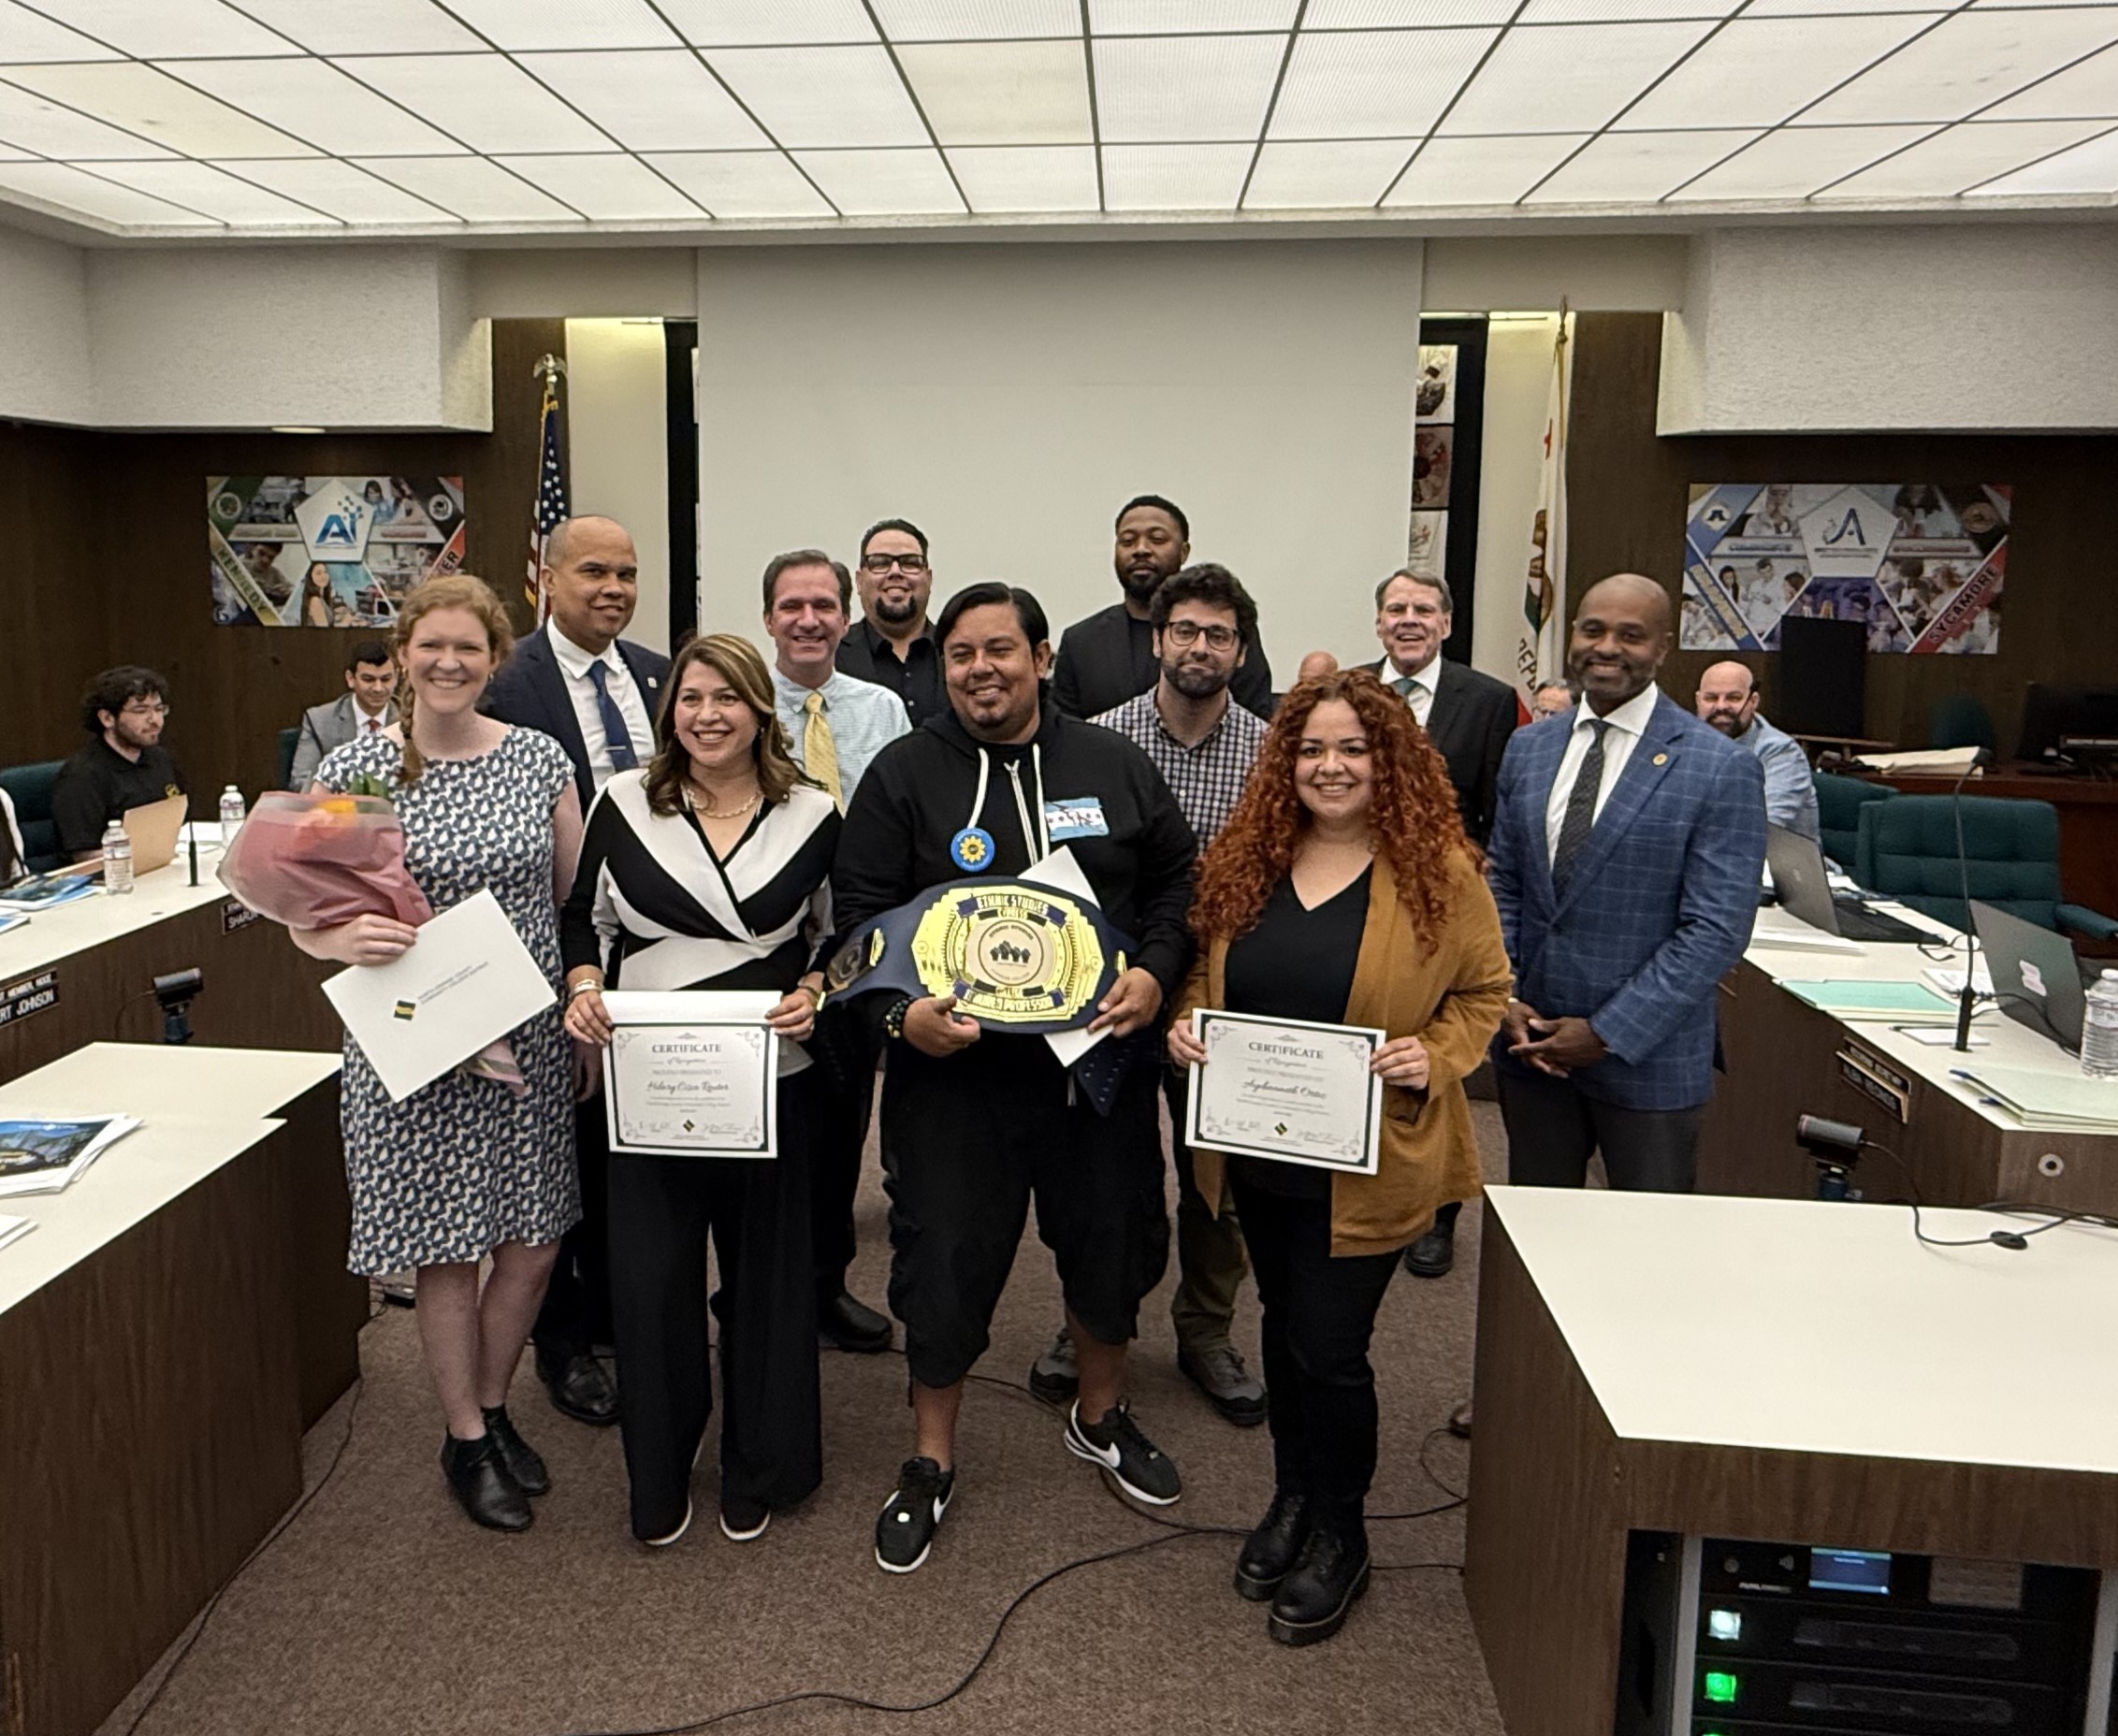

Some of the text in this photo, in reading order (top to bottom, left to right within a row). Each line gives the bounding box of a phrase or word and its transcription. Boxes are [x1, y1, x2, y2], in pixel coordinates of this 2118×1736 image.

[1926, 564, 1998, 645] SYCAMORE
[976, 895, 1050, 917] ETHNIC STUDIES
[652, 1044, 722, 1053] CERTIFICATE
[1248, 1042, 1324, 1060] CERTIFICATE
